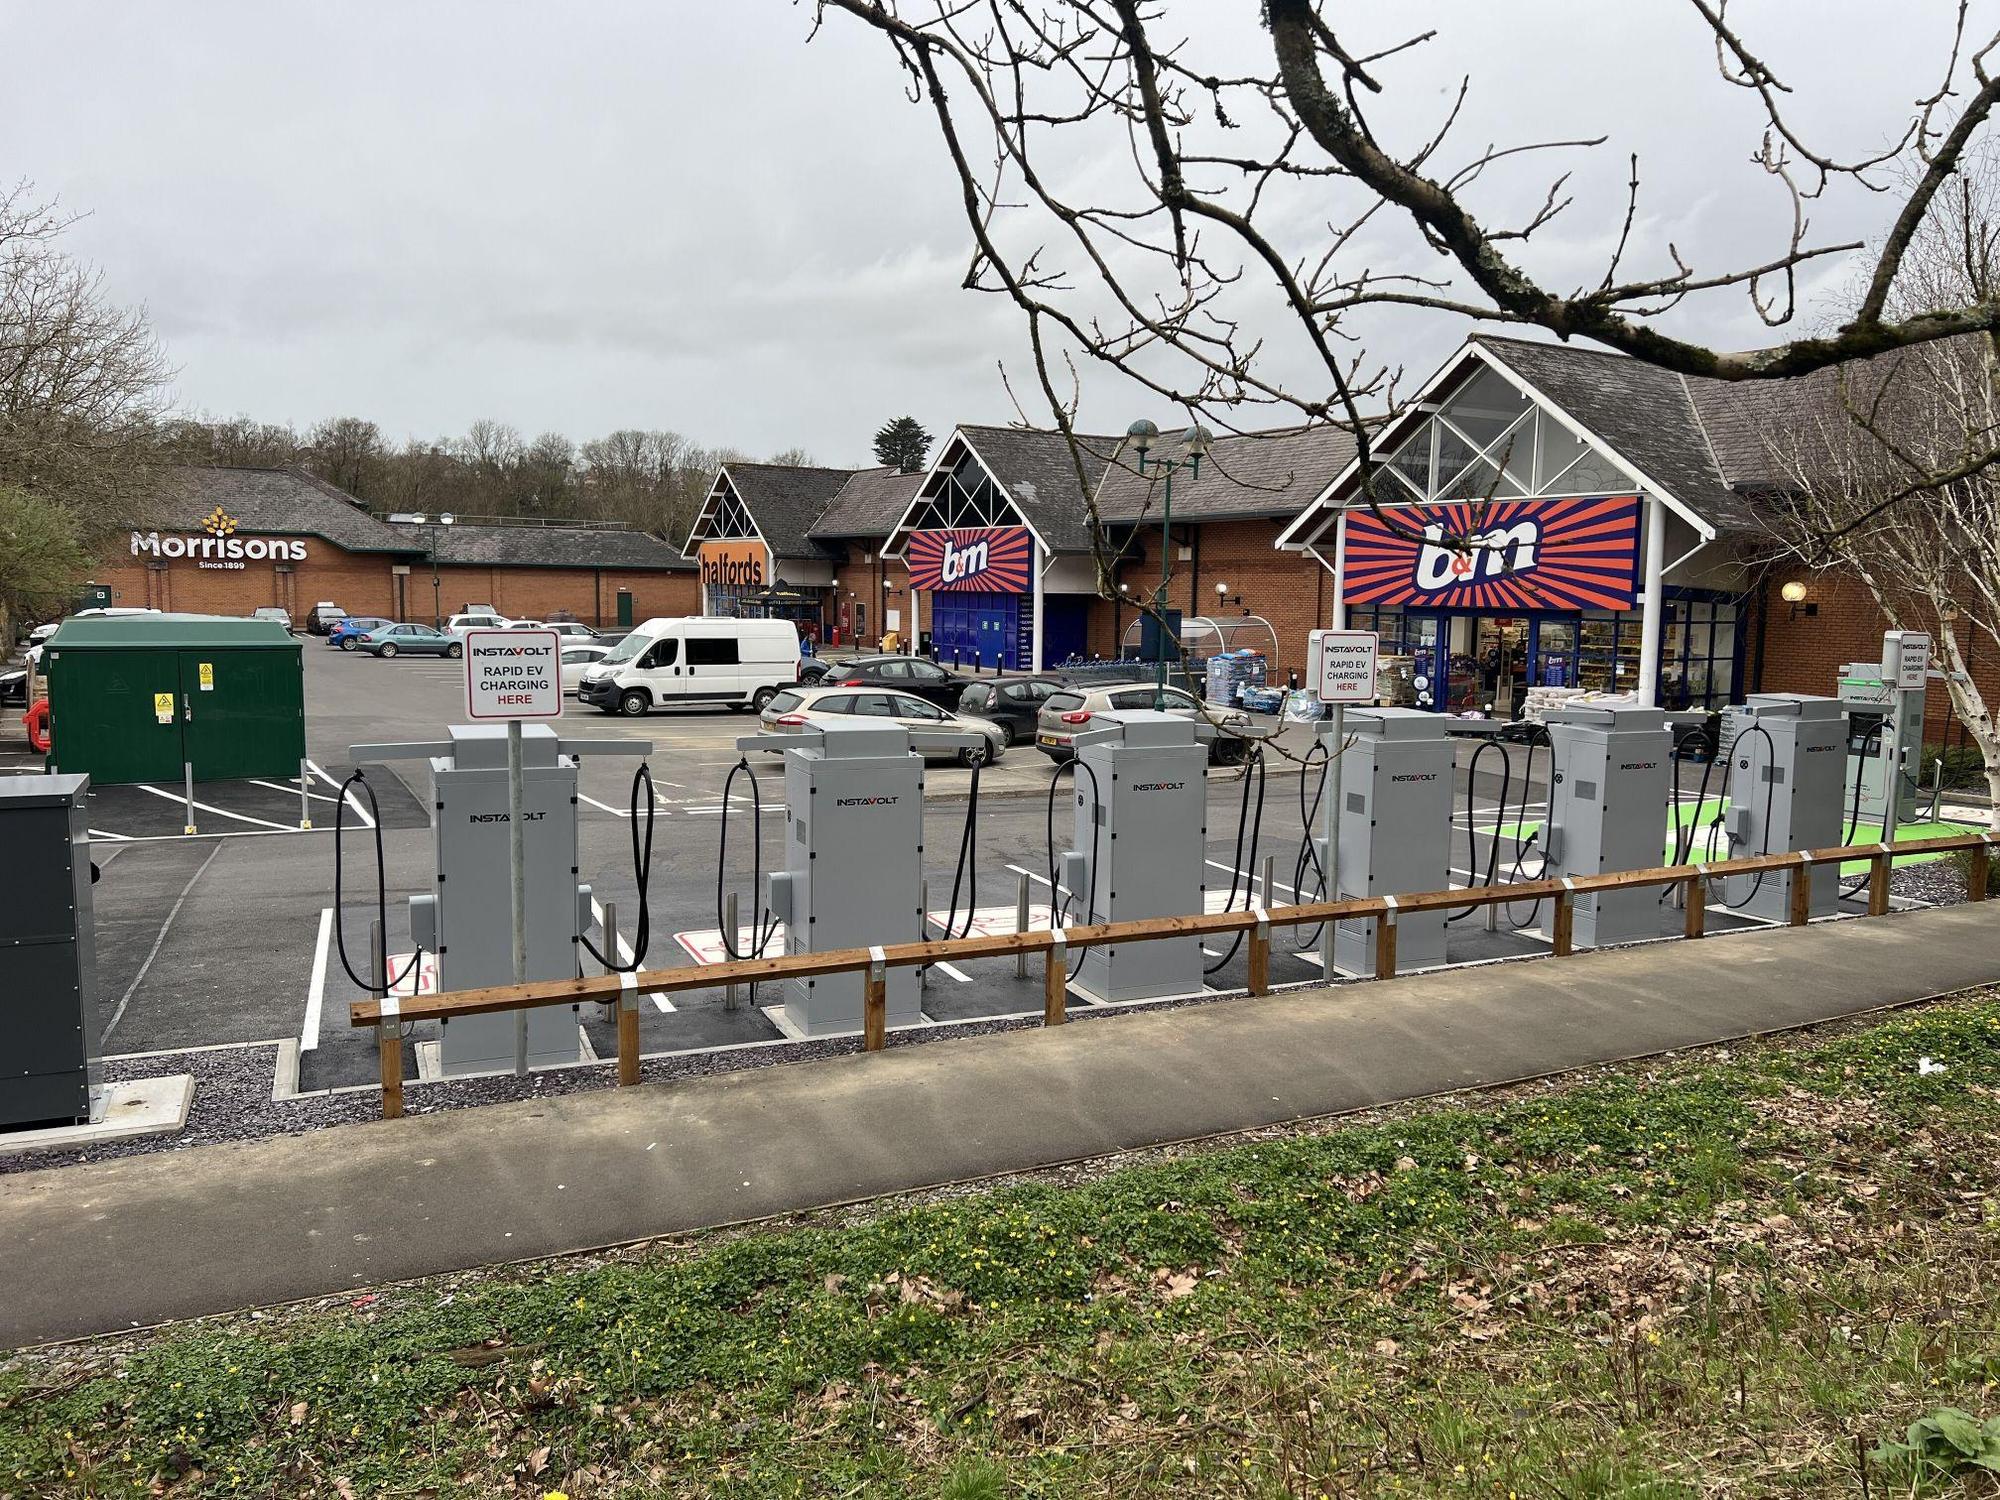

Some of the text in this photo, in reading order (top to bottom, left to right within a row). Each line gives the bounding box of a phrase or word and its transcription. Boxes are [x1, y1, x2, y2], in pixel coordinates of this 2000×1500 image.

[130, 529, 308, 560] Morrisons
[199, 561, 245, 570] Since 1899
[942, 541, 989, 582] b&m
[702, 552, 762, 584] halfords
[473, 647, 552, 656] INSTAVOLT
[484, 666, 543, 676] RAPID EV
[480, 680, 549, 690] CHARGING
[1336, 683, 1358, 691] HERE
[498, 694, 532, 704] HERE
[1391, 774, 1437, 782] INSTAVOLT
[1133, 782, 1185, 792] INSTAVOLT
[836, 797, 898, 806] INSTAVOLT
[469, 812, 546, 823] INSTAOLT
